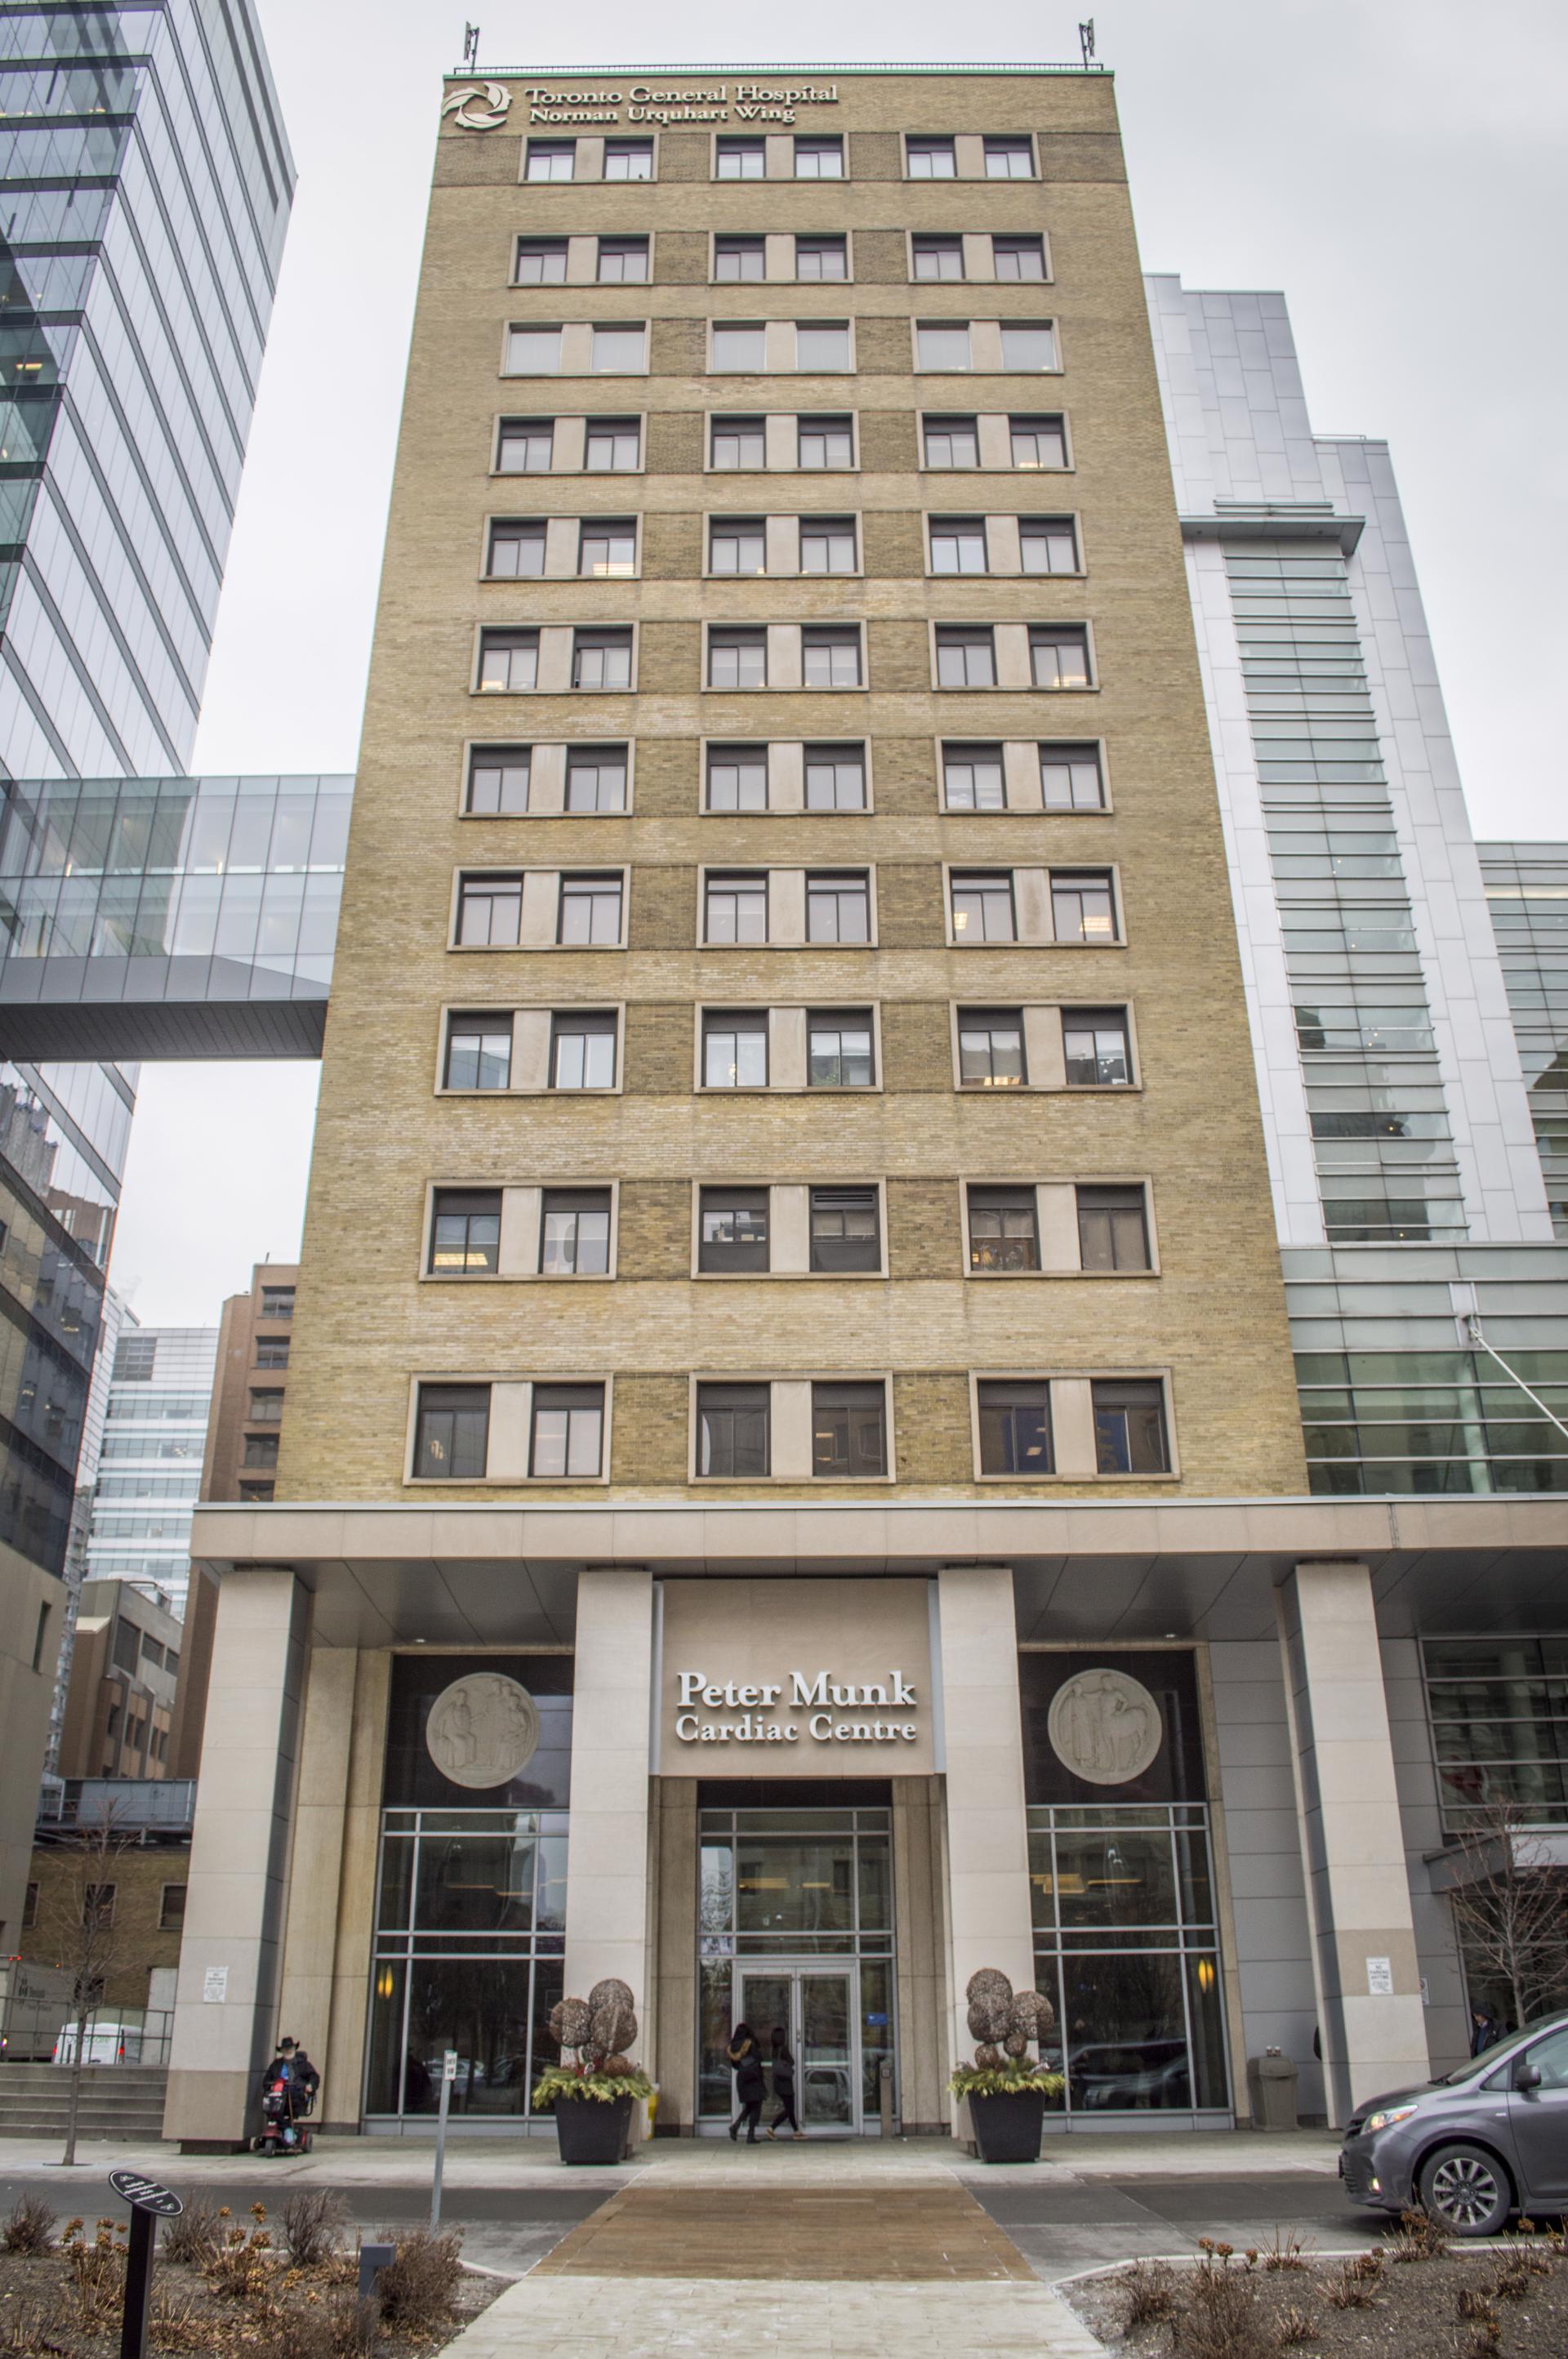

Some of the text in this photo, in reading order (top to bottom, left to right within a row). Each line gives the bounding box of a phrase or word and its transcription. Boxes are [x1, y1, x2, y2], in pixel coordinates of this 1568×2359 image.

[524, 85, 839, 106] Toronto General Hospital
[530, 106, 796, 125] Norman Urquhart Wing
[677, 1670, 917, 1707] Peter Munk
[675, 1714, 916, 1741] Cardiac Centre
